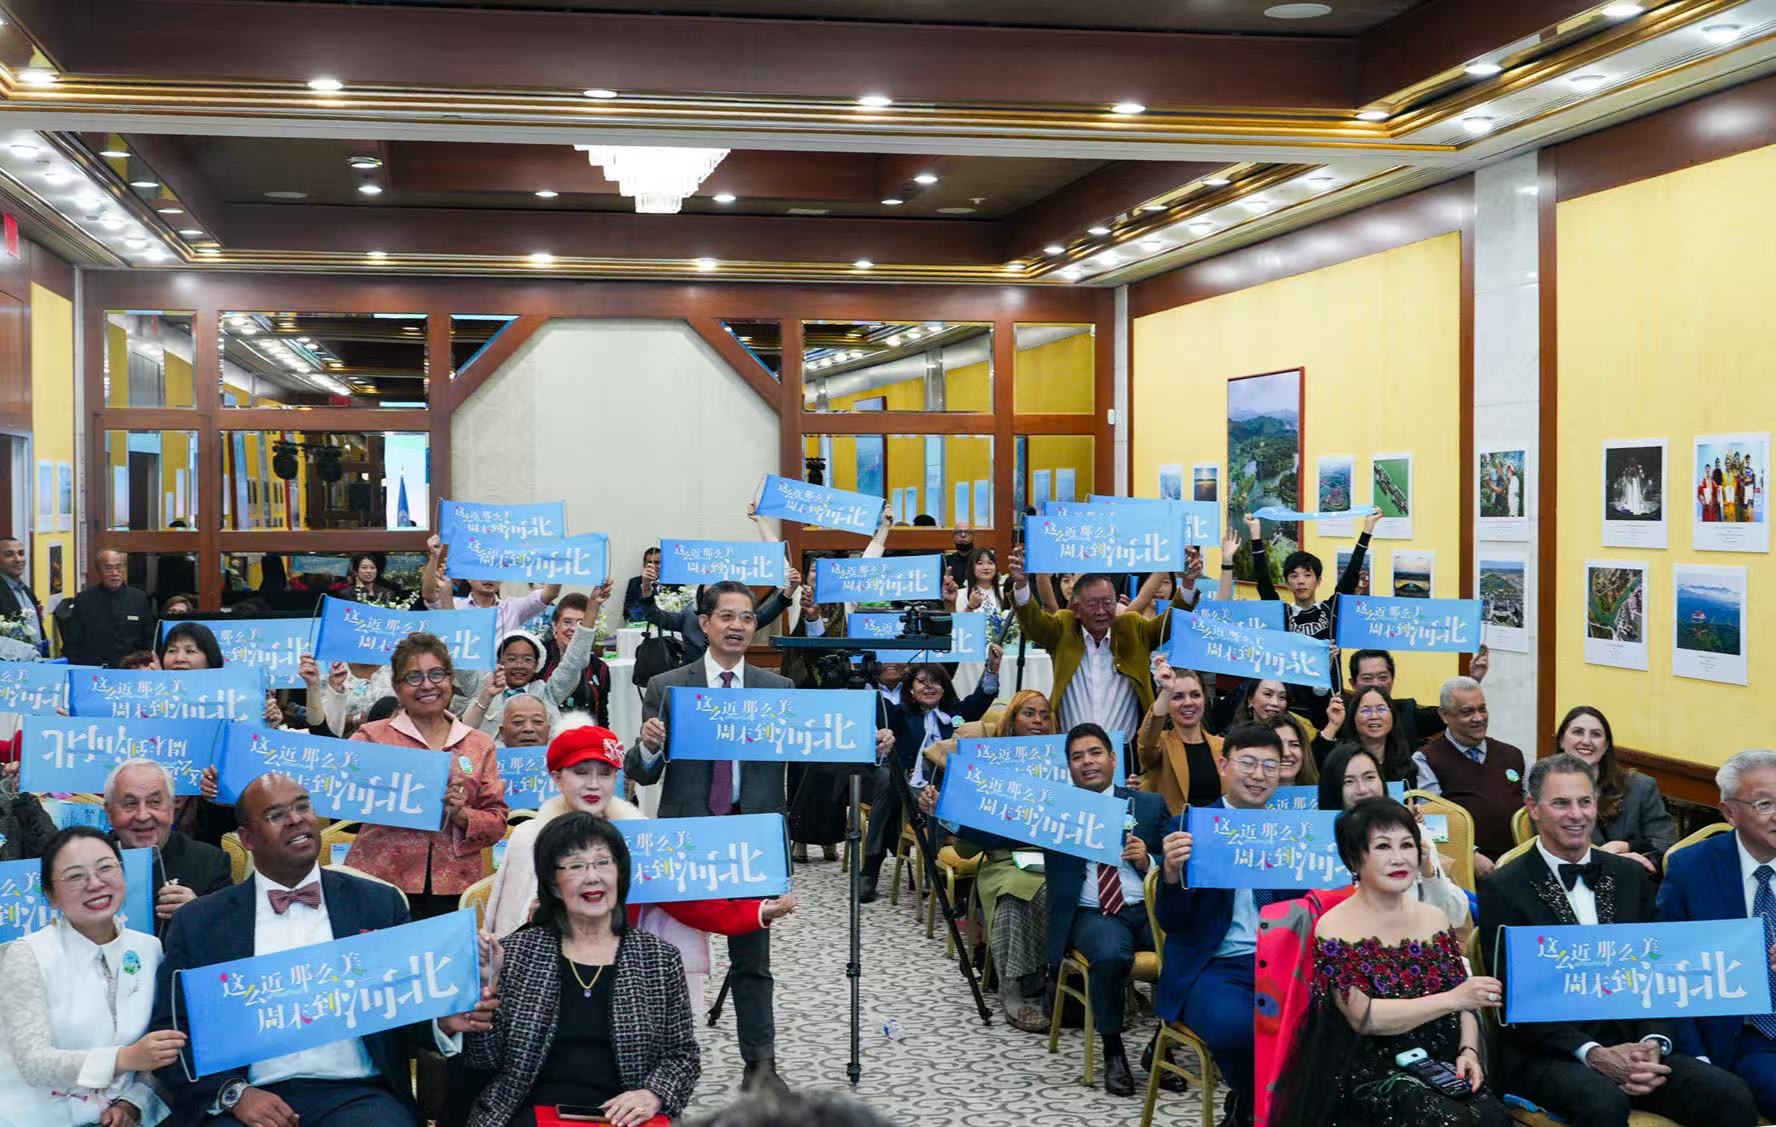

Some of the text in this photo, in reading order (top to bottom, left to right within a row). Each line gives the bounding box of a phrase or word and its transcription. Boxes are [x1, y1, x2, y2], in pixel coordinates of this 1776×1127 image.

[1044, 521, 1120, 542] 这么近那么美
[1060, 533, 1170, 567] 周末到河北
[688, 556, 774, 581] 周末到河北
[843, 569, 929, 597] 周末到河北
[1356, 601, 1425, 621] 这么近那么美
[1369, 615, 1468, 647] 周末到河北
[1207, 642, 1321, 678] 周末到河北
[92, 675, 188, 700] 这么近那么美
[696, 694, 797, 721] 这么近那么美
[716, 713, 857, 756] 周末到河北
[251, 734, 360, 773] 这么近那么美
[976, 743, 1058, 767] 这么近那么美
[965, 764, 1053, 804] 这么近那么美
[978, 796, 1105, 850] 周末到河北
[1214, 816, 1314, 845] 这么近那么美
[632, 842, 768, 893] 末到河北
[1234, 841, 1353, 882] 周末到河
[1537, 935, 1665, 970] 这么近那么美
[220, 952, 366, 1007] 这么近那么美
[258, 952, 460, 1033] 周末到河北
[1563, 951, 1748, 1009] 周末到河北
